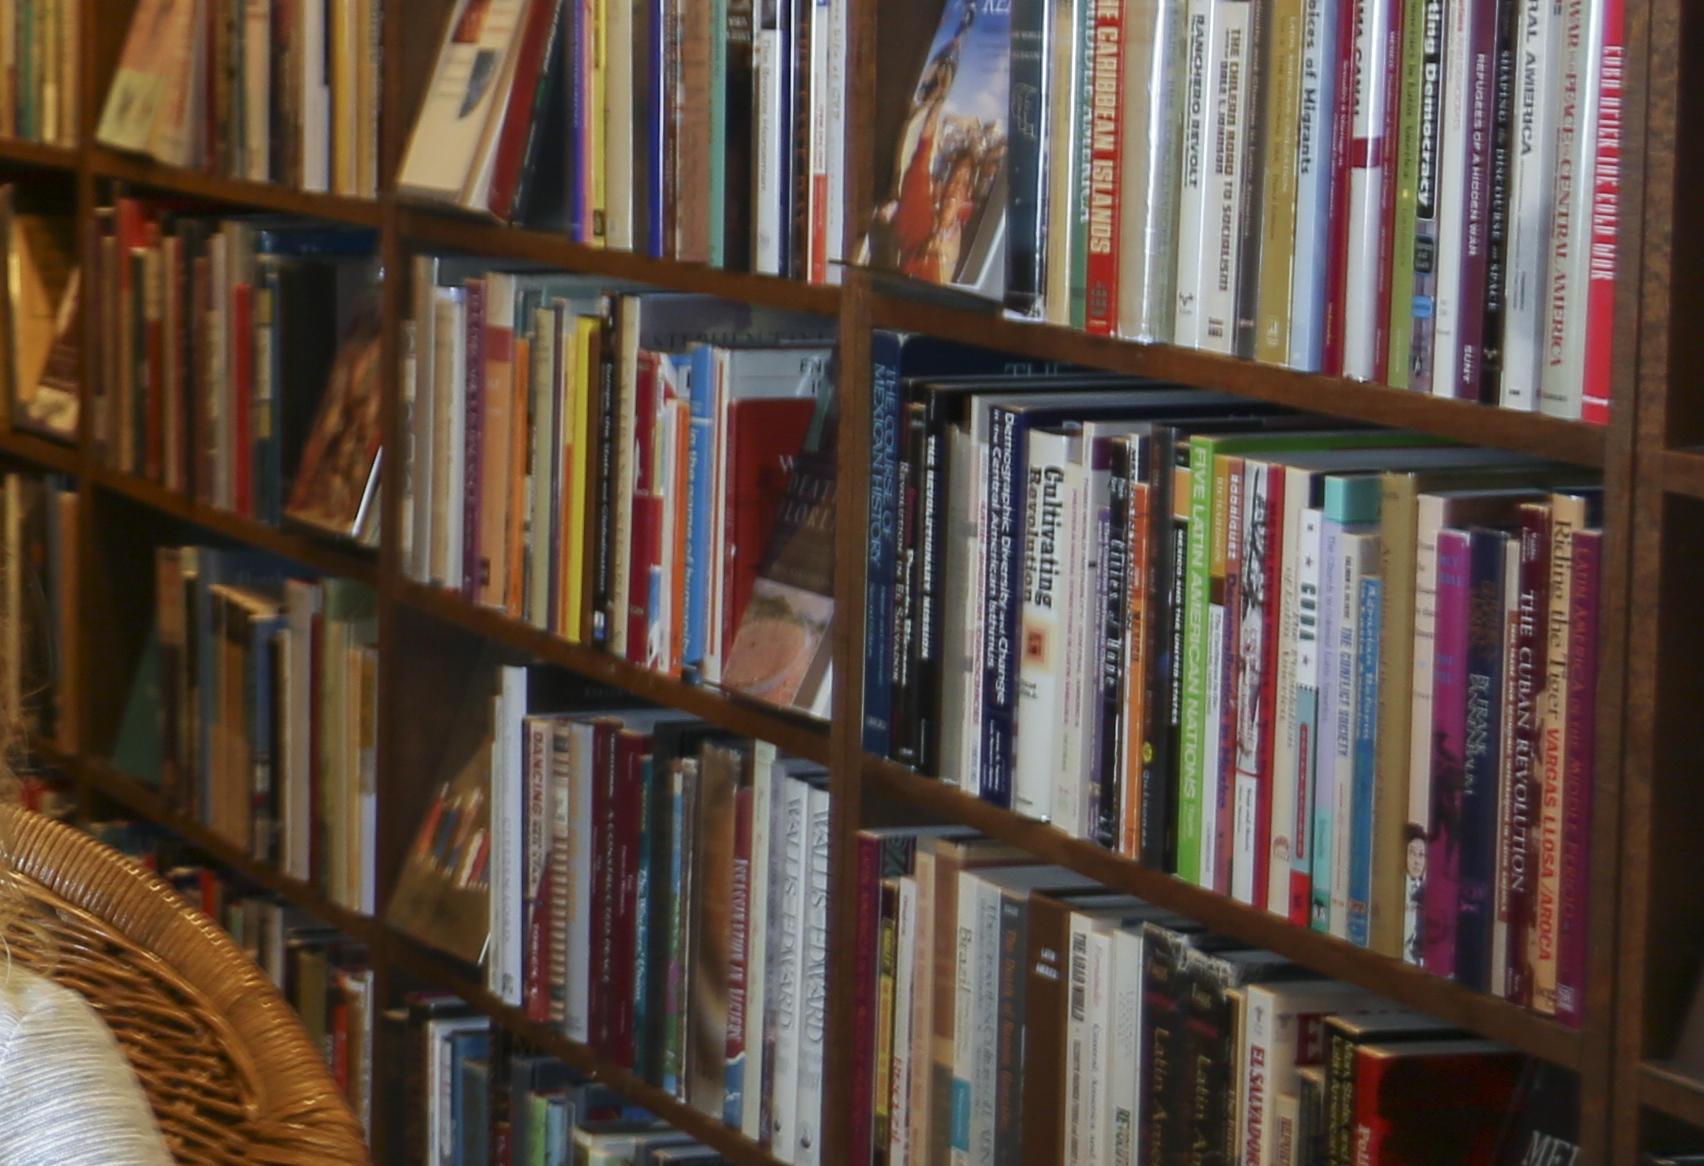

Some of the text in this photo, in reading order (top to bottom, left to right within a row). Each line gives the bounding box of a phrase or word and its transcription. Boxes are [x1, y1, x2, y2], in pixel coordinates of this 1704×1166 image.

[1191, 14, 1205, 115] RANCHERO
[1230, 29, 1242, 57] THE
[1306, 57, 1317, 79] of
[1090, 26, 1119, 255] CARIBBEAN ISLANDS
[1300, 88, 1316, 175] Migrants
[1417, 63, 1438, 207] Democracy
[1520, 51, 1536, 156] AMERICA
[1561, 73, 1577, 142] PEACE
[1597, 97, 1621, 149] AFTER
[1188, 119, 1200, 189] REVOLT
[1468, 54, 1485, 257] REFUGEES OF A HIDDEN WAR
[1487, 50, 1510, 312] SHAPING DISCOURSE SPACE
[1595, 156, 1619, 187] THE
[1219, 204, 1233, 292] SOCIALISM
[1555, 158, 1573, 265] CENTRAL
[1592, 193, 1618, 236] COLD
[1590, 243, 1616, 281] WAR
[1550, 268, 1567, 367] AMERICA
[687, 449, 700, 479] the
[689, 428, 701, 446] in
[869, 362, 887, 569] MEXICAN HISTORY
[881, 365, 898, 545] THE COURSE OF
[991, 446, 1004, 508] Central
[992, 423, 1000, 445] the
[920, 435, 937, 660] THE REVOLUTIONARY MISSION
[988, 511, 1003, 597] American
[995, 412, 1016, 707] Demographic Diversity and Change
[1023, 466, 1043, 605] Revolution
[1035, 466, 1065, 609] Cultivating
[1574, 546, 1591, 598] LATIN
[986, 599, 1001, 669] Isthmus
[1171, 529, 1185, 726] MEXICO AND THE UNITED STATES
[1183, 447, 1209, 800] FIVE LATIN AMERICAN NATIONS
[1547, 520, 1573, 720] Riding the Tiger
[1571, 606, 1589, 692] AMERICA
[532, 730, 545, 817] DANCING
[1511, 590, 1536, 893] THE CUBAN REVOLUTION
[1544, 728, 1560, 808] VARGAS
[1541, 815, 1556, 878] LLOSA
[778, 797, 802, 1029] WALLIS EDWARD
[804, 809, 831, 1043] WALLIS EDWARD
[1073, 932, 1087, 954] THE
[957, 926, 975, 994] Brazil
[1071, 985, 1085, 1023] WORLD
[1153, 1027, 1172, 1093] Latin
[1195, 1055, 1214, 1121] Latin
[1250, 1045, 1266, 1066] EL
[1277, 1115, 1293, 1165] REPORT
[1328, 1078, 1343, 1156] American
